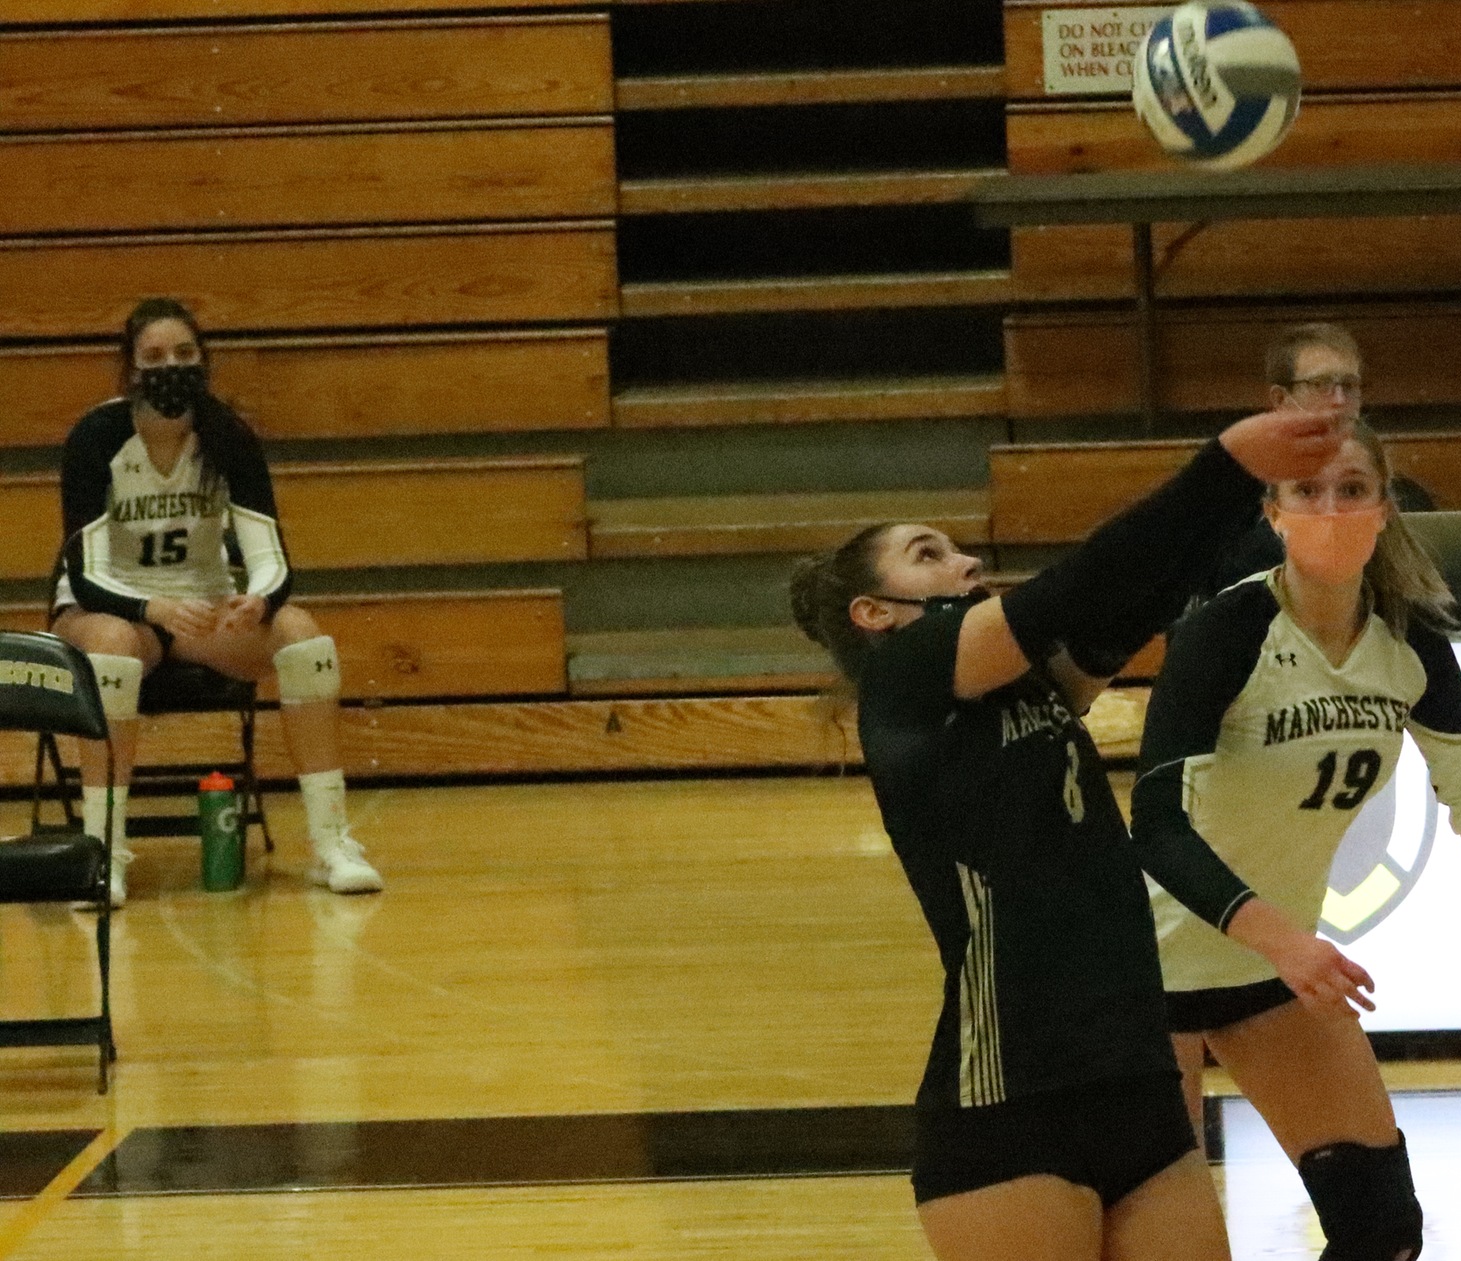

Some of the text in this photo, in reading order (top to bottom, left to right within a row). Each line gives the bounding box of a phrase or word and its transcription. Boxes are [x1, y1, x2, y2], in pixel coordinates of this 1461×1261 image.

[1059, 24, 1084, 39] DO
[1091, 22, 1122, 38] NOT
[1060, 43, 1084, 58] ON
[1061, 62, 1109, 77] WHEN
[139, 528, 188, 567] 15
[1299, 748, 1382, 810] 19
